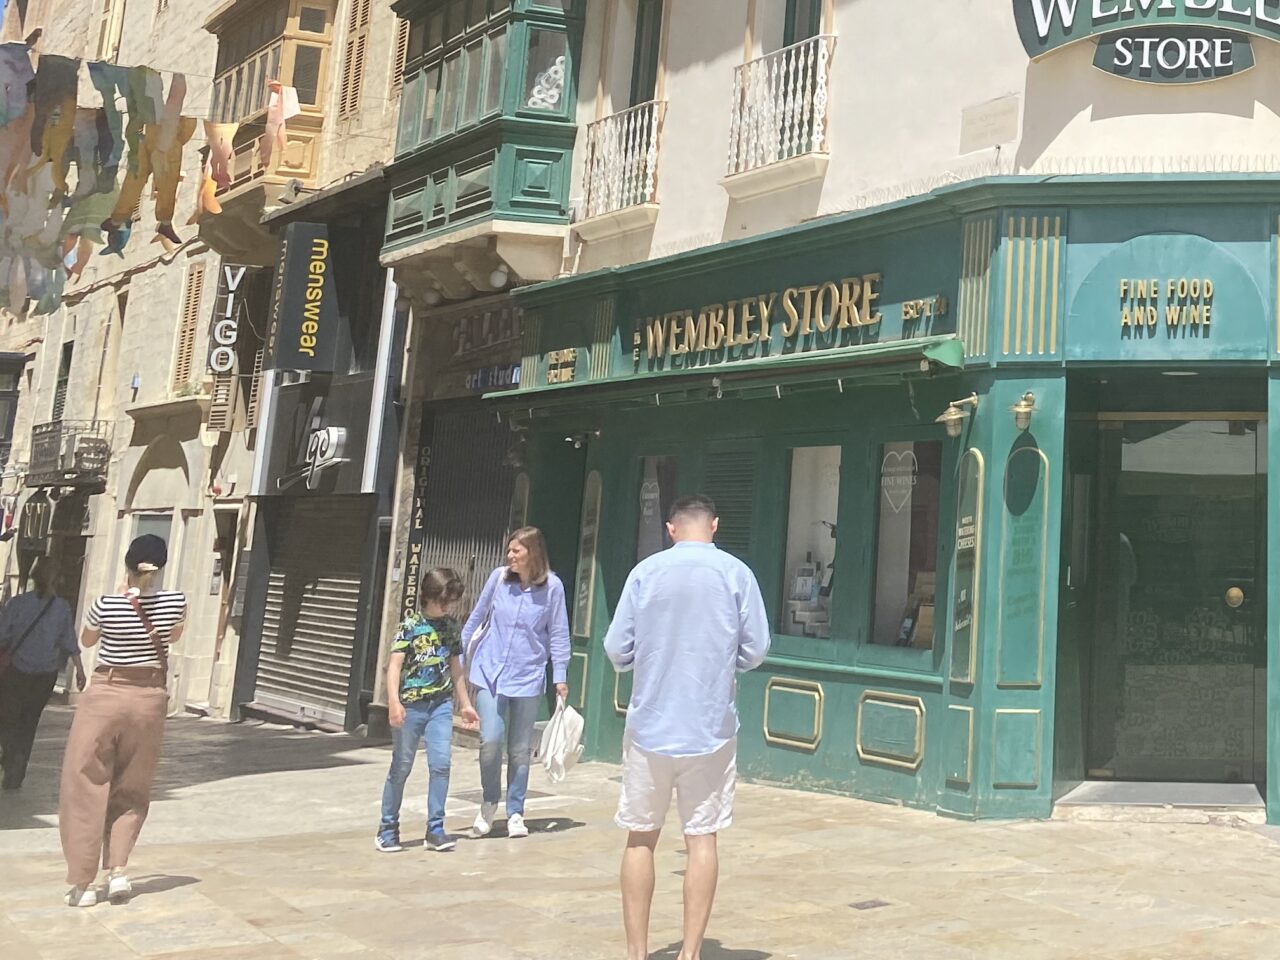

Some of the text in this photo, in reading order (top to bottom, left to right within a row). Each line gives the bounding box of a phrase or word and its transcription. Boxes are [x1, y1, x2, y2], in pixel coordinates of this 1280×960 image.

[1114, 37, 1233, 69] STORE
[210, 266, 247, 372] VIGO
[299, 239, 329, 357] menswear
[647, 292, 778, 359] WEMBLEY
[781, 272, 883, 337] STORE
[1120, 278, 1213, 298] FINE FOOD
[1121, 304, 1211, 326] AND WINE
[414, 446, 431, 529] ORIGINAL
[404, 543, 422, 618] WATERCO
